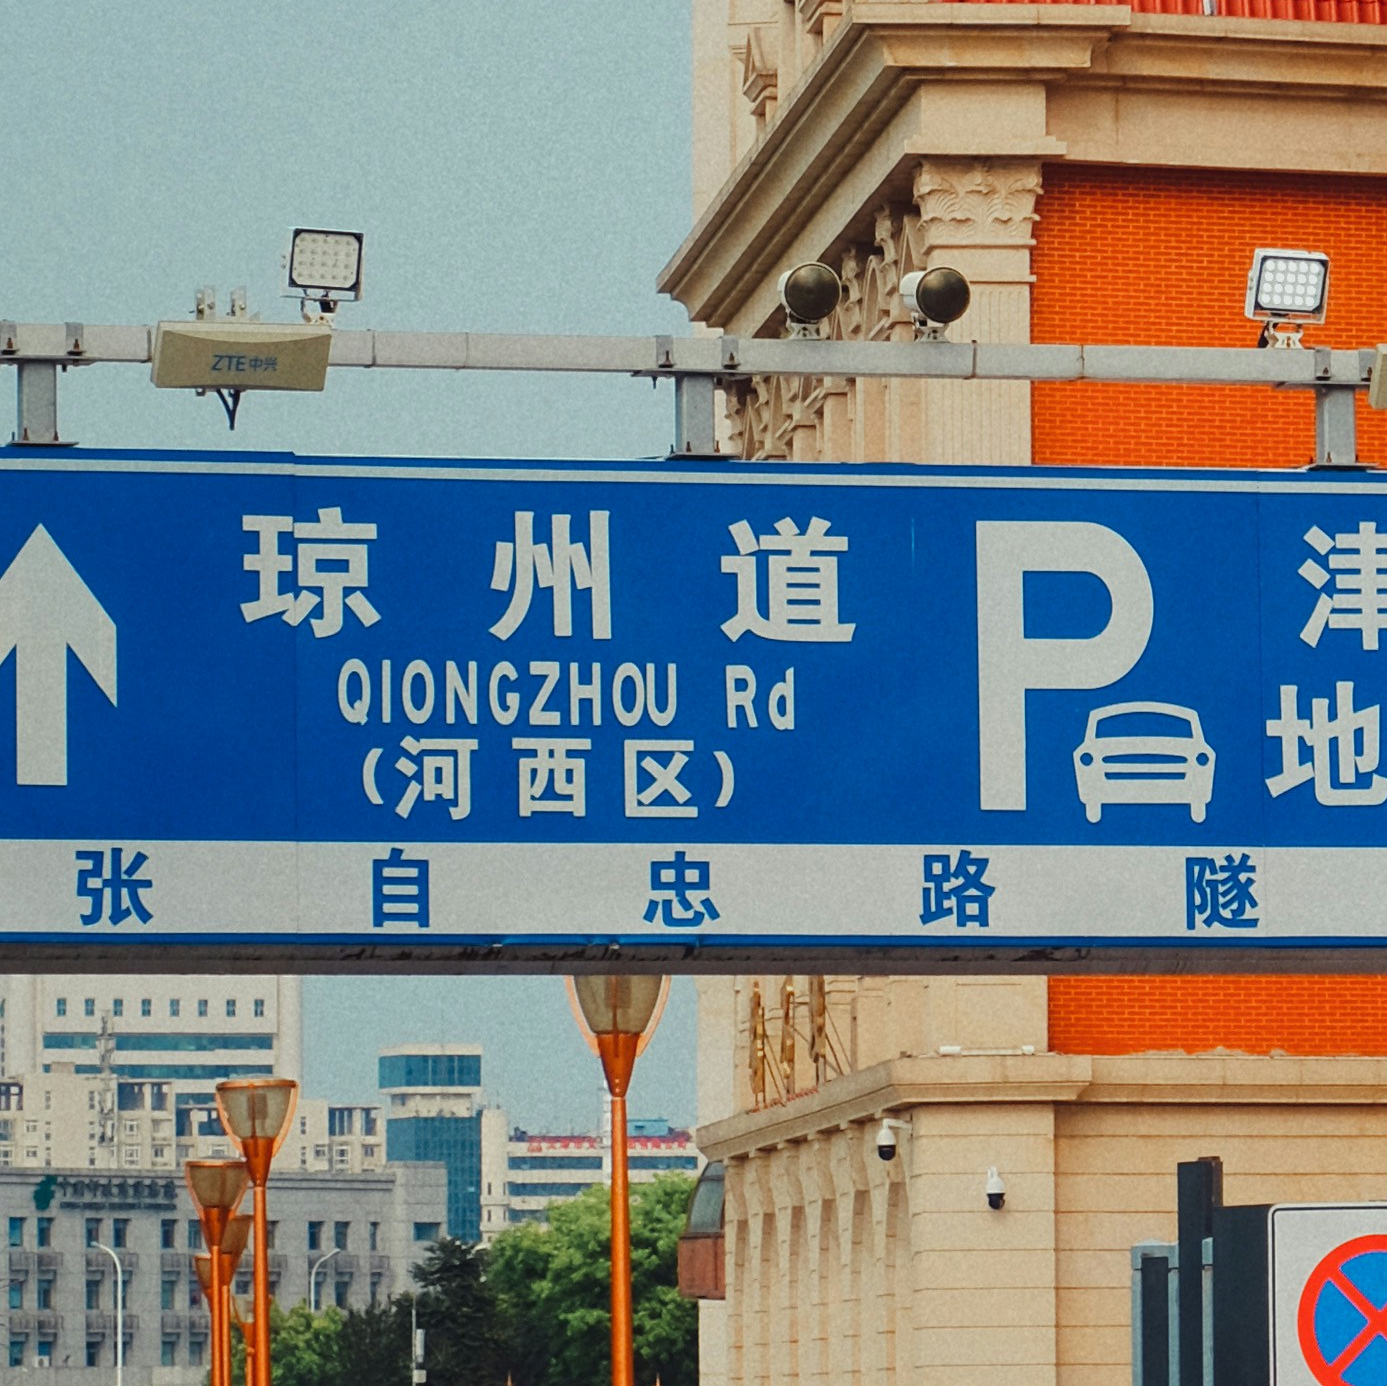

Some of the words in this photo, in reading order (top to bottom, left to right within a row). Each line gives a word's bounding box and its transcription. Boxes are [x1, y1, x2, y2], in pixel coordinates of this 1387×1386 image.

[241, 507, 856, 643] 琼州道
[337, 658, 677, 727] QIONGZHOU
[725, 664, 795, 731] Rd
[975, 520, 1155, 812] P
[362, 735, 735, 821] (河西区)
